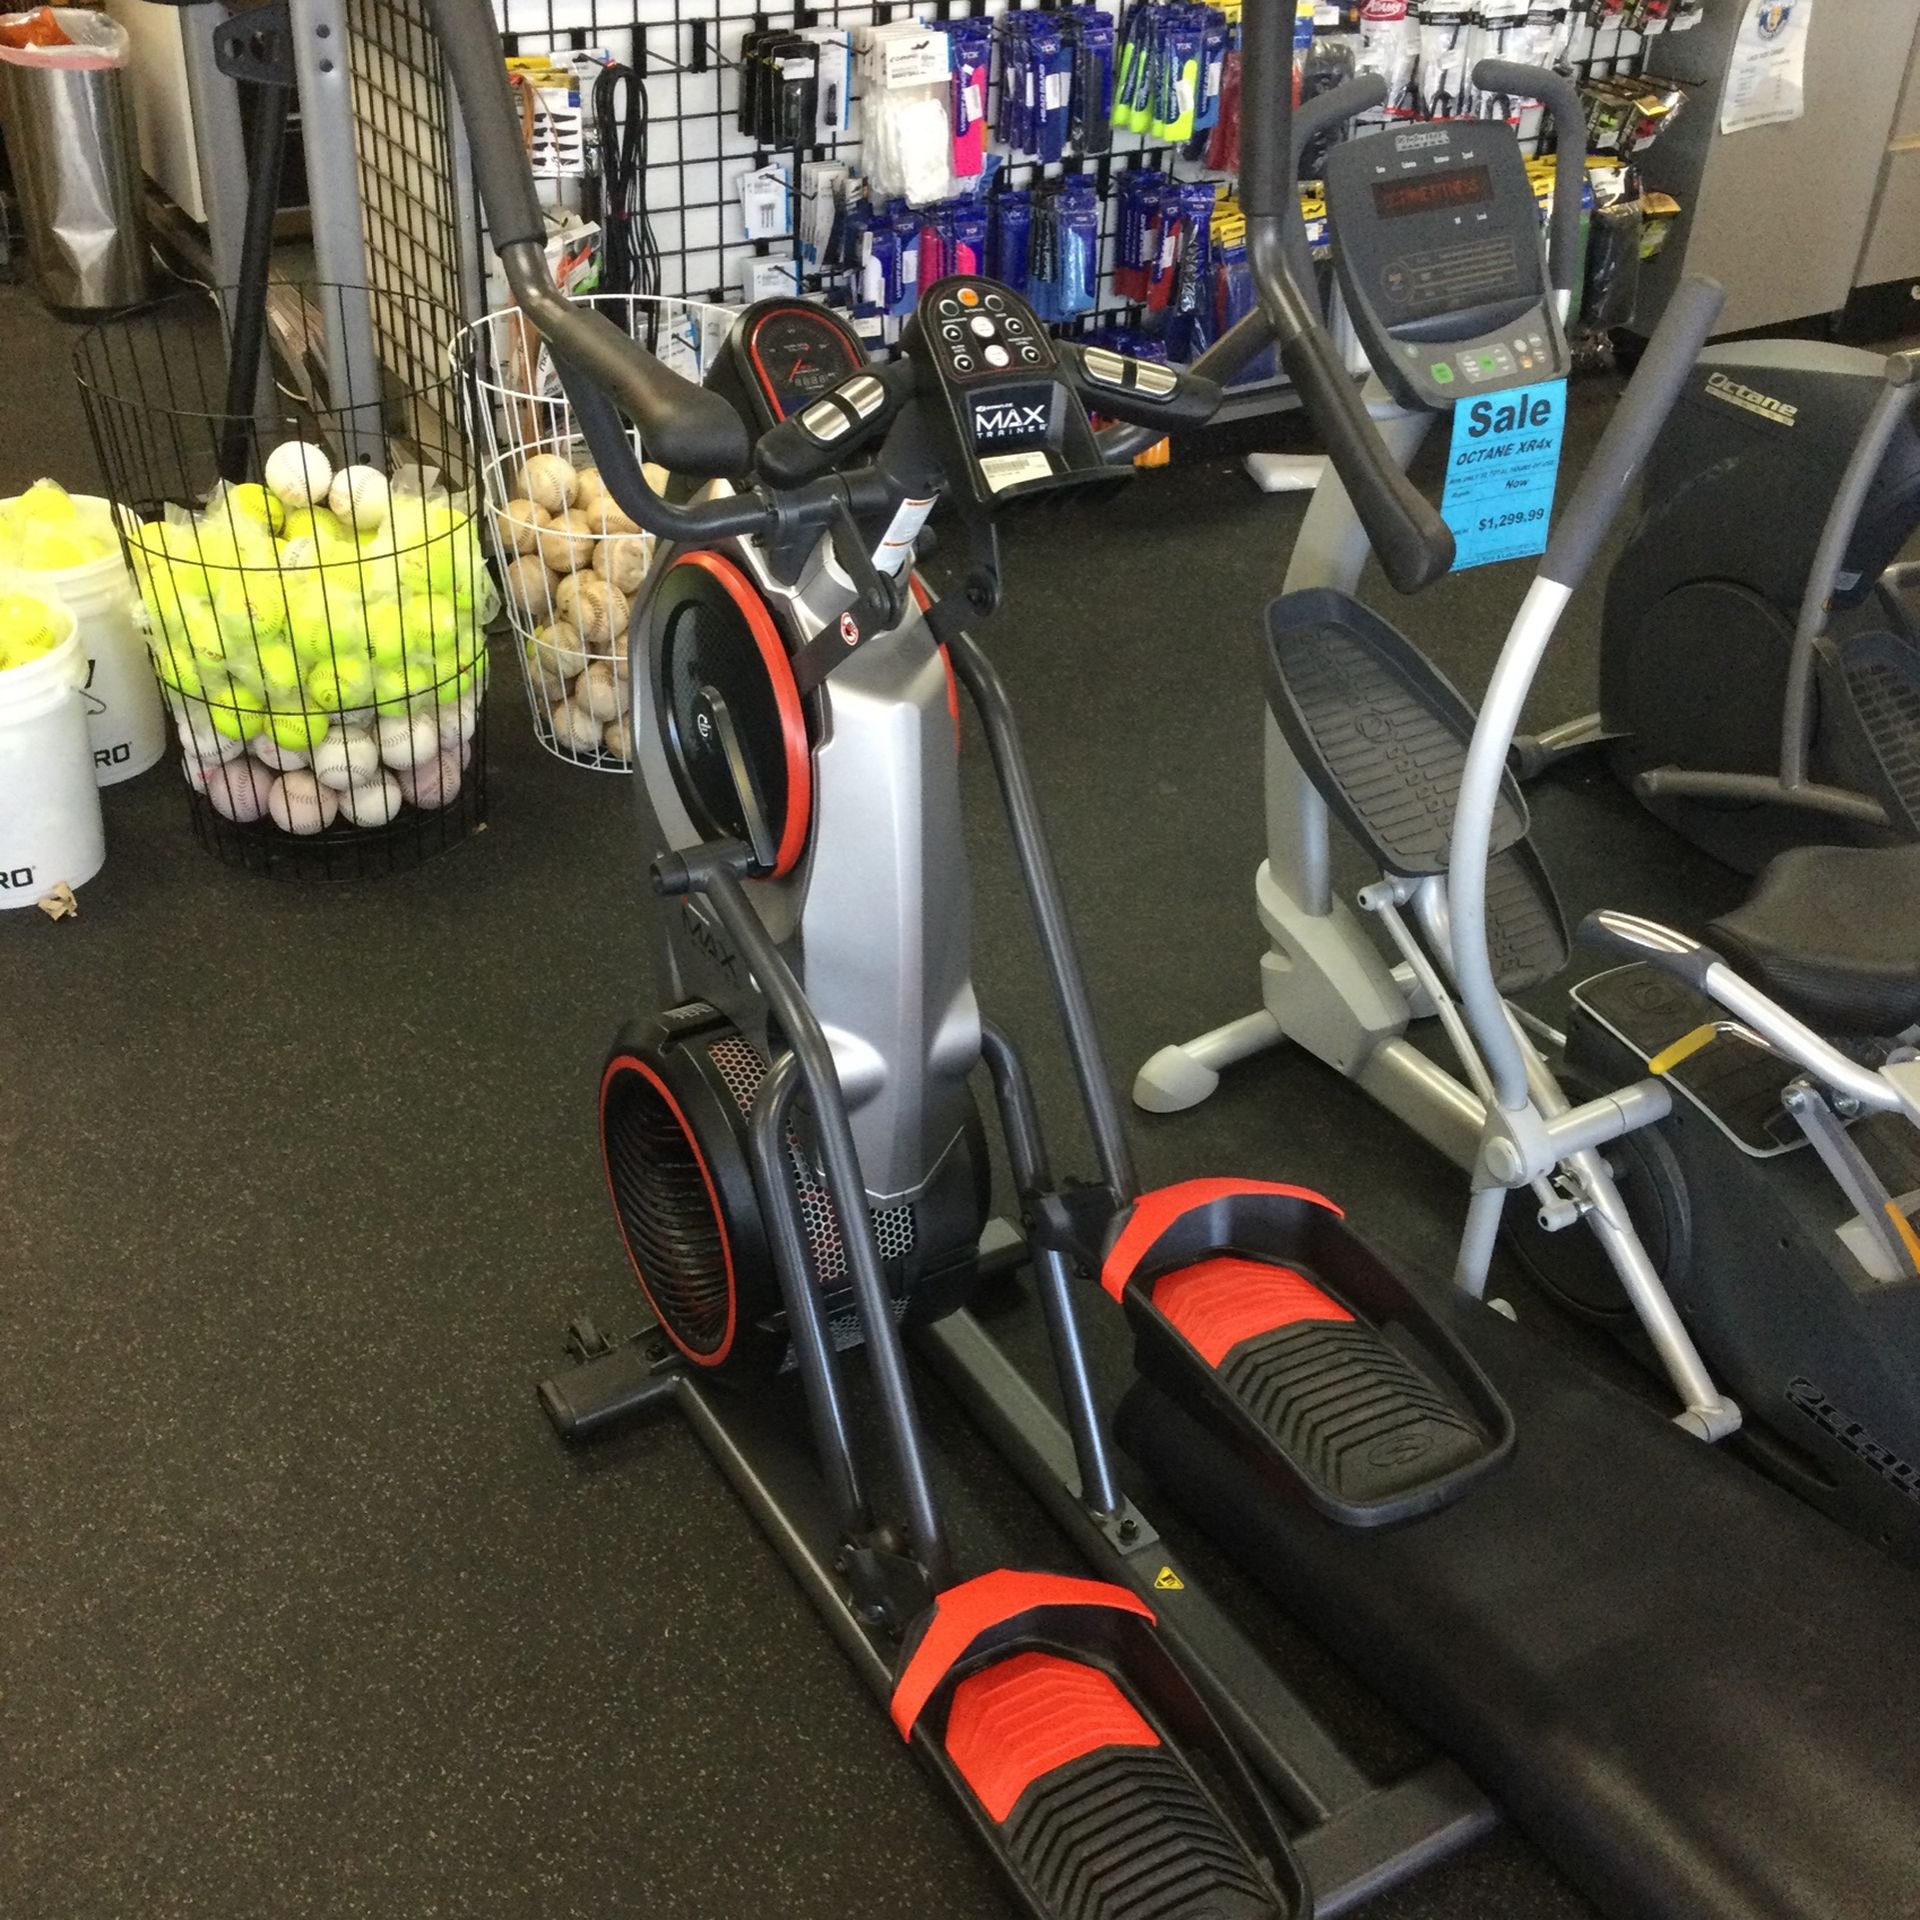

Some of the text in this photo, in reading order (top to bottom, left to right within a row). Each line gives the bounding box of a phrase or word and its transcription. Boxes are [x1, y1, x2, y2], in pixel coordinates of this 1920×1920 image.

[1038, 63, 1046, 93] BAND
[1708, 372, 1798, 417] Octane
[976, 404, 1046, 432] MAX
[1468, 393, 1551, 438] Sale
[976, 423, 1048, 439] TRAINER
[1456, 443, 1515, 466] OCTANE
[1478, 508, 1544, 532] $1,299.99
